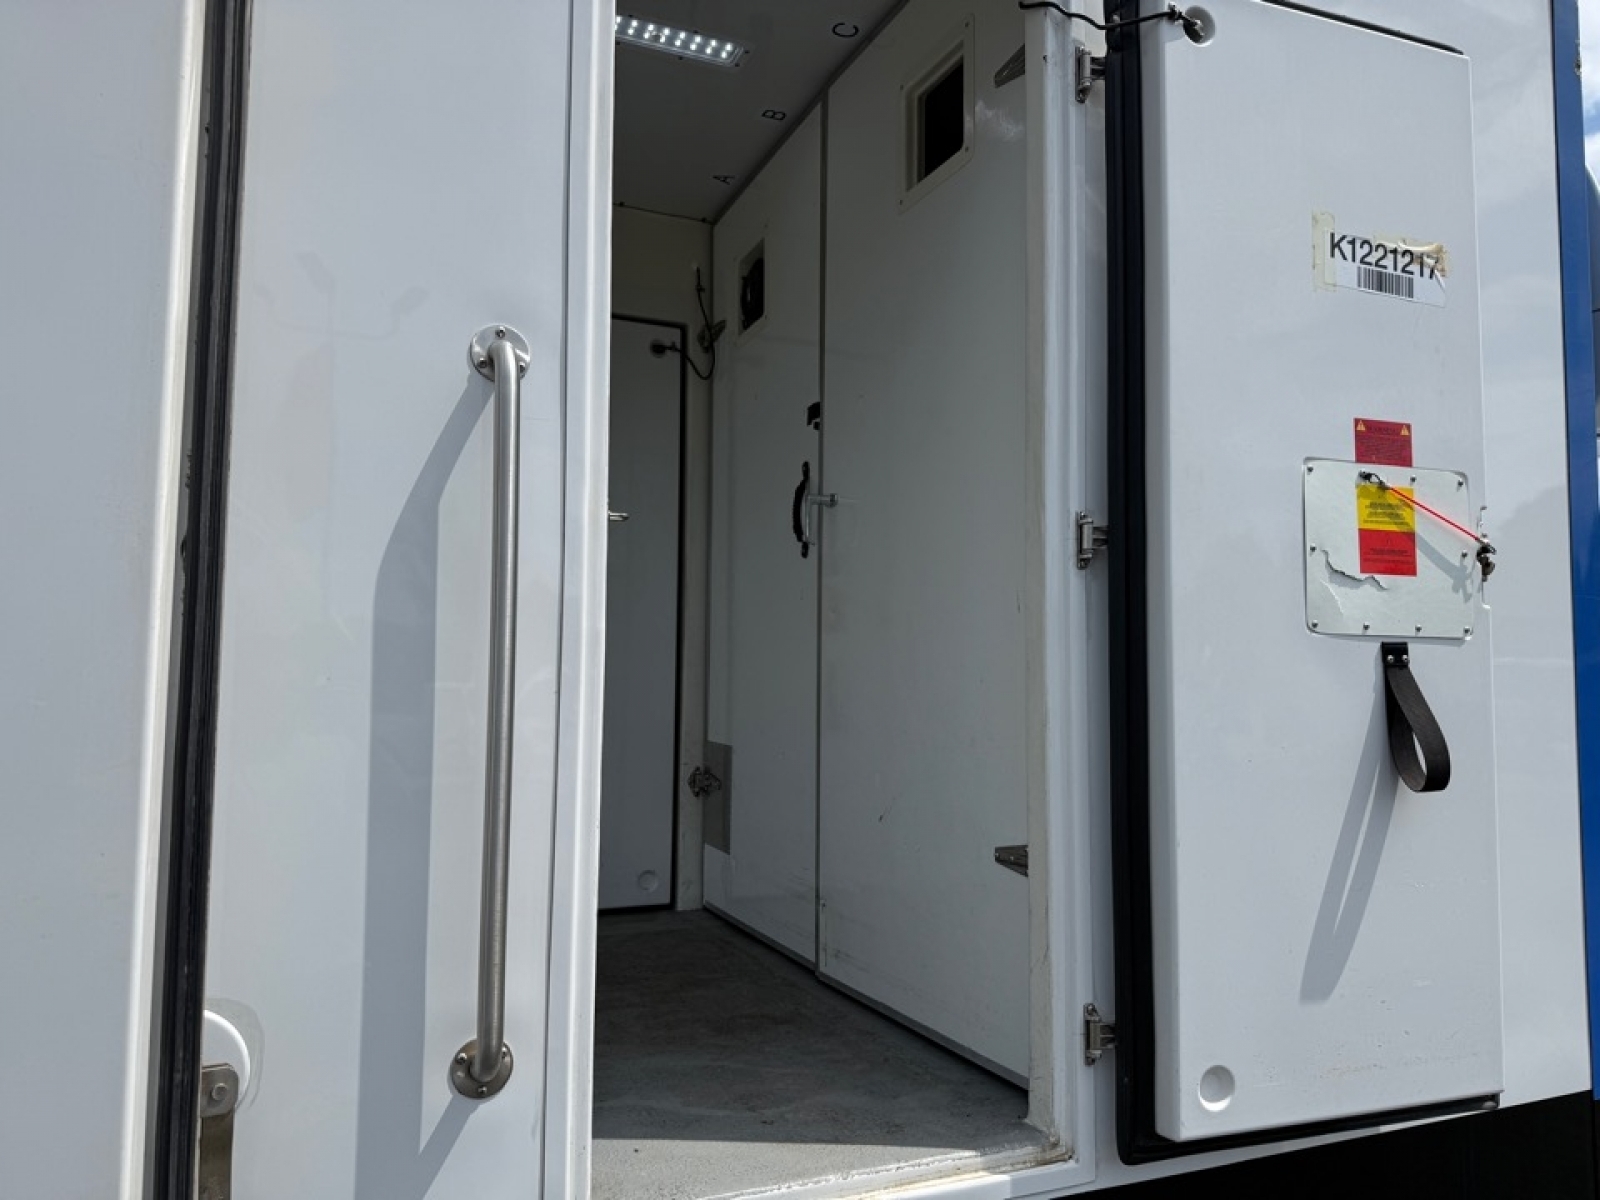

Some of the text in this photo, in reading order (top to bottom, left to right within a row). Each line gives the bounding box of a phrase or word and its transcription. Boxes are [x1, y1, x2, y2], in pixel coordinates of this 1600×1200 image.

[832, 22, 859, 38] C
[762, 109, 786, 121] B
[713, 175, 734, 186] A
[1329, 232, 1439, 280] K1221217
